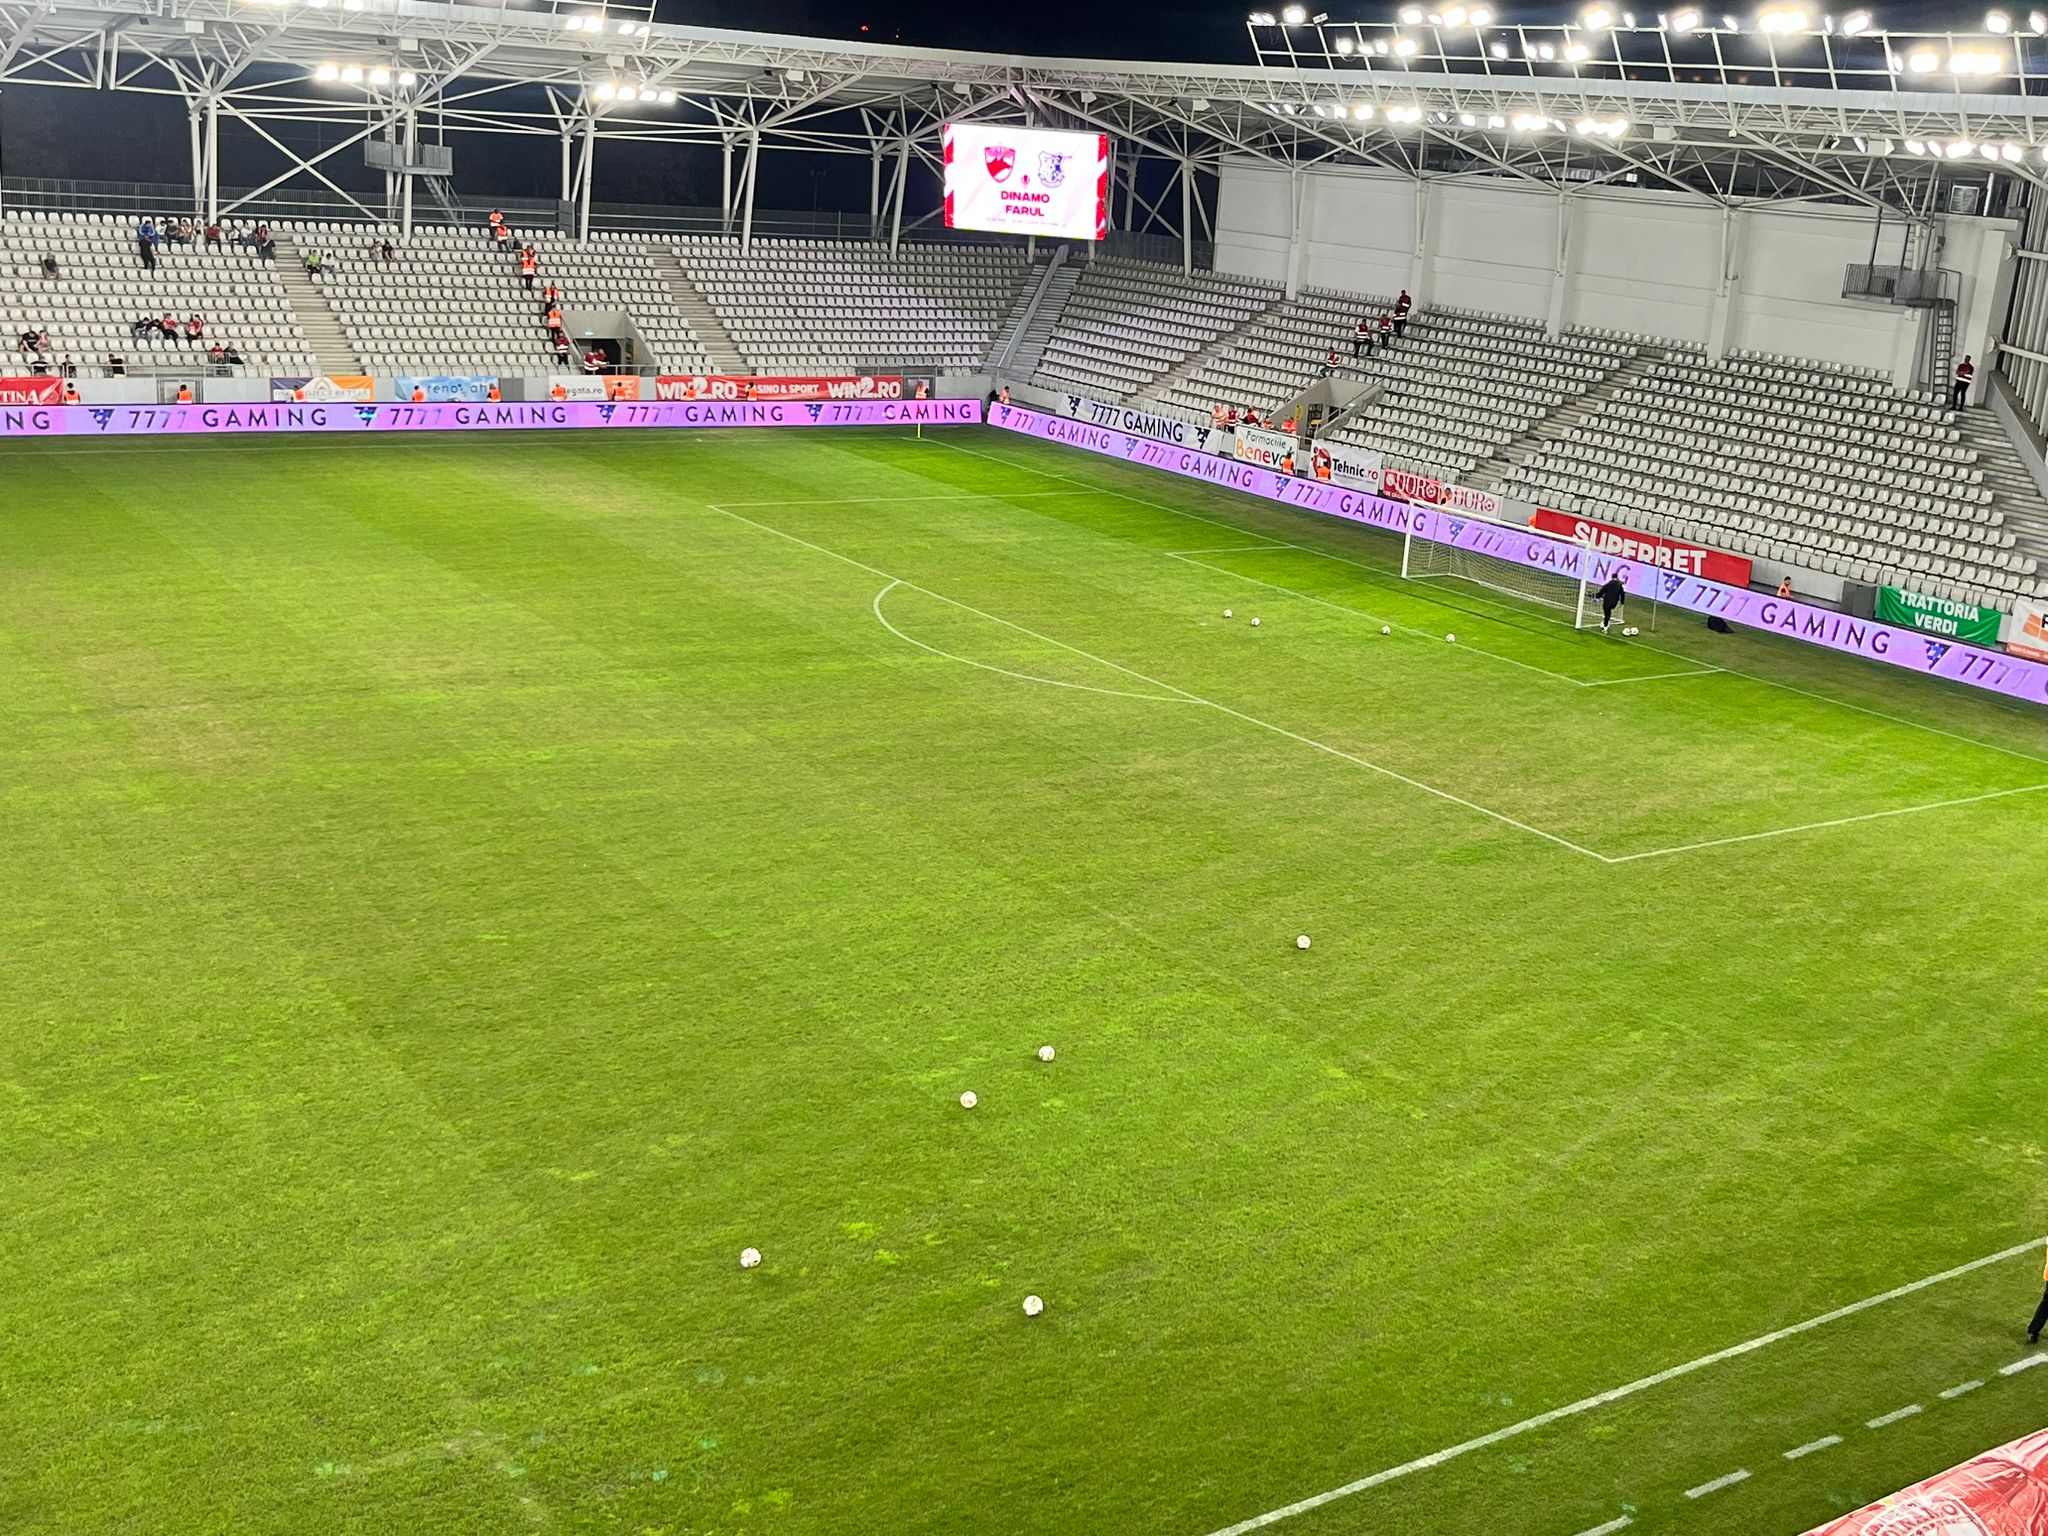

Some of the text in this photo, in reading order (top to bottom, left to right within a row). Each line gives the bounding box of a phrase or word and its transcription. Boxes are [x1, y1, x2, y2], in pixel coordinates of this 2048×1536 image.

[1001, 190, 1050, 203] DINAMO
[1005, 204, 1045, 217] FARUL
[745, 384, 820, 395] CSINO & SPORT
[827, 377, 901, 399] WIN2.RO
[203, 408, 327, 428] GAMING
[455, 406, 567, 425] GAMING
[686, 405, 783, 423] GAMING
[884, 403, 972, 420] GAMING
[1091, 404, 1184, 442] 7777 GAMING
[1047, 420, 1111, 449] GAMING
[1180, 454, 1254, 487] GAMING
[1332, 457, 1379, 480] Tehnic.ro
[1340, 495, 1424, 532] GAMING
[1899, 592, 1980, 623] TRATTORIA
[1761, 602, 1891, 654] GAMING
[1914, 612, 1959, 636] VERDI
